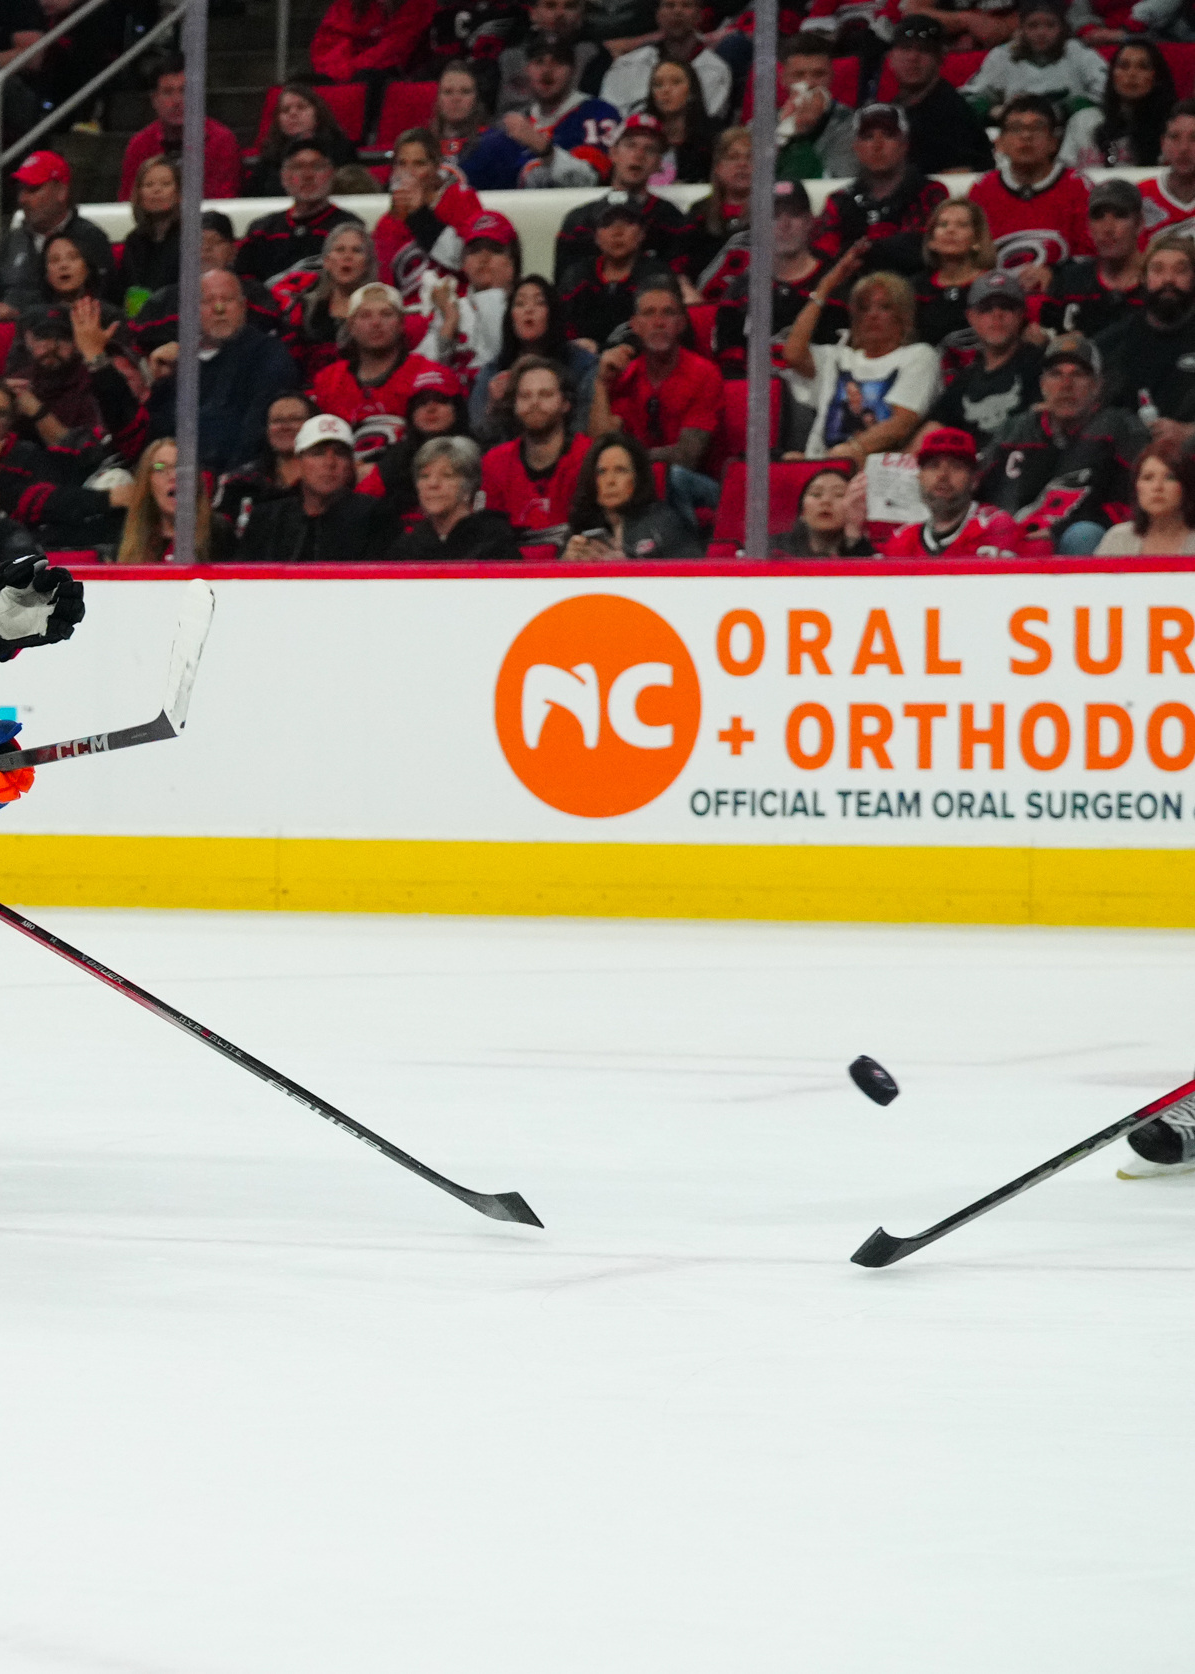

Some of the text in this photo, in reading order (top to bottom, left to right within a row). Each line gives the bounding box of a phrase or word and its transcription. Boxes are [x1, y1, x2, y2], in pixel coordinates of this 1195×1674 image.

[583, 118, 620, 148] 13
[715, 605, 1195, 678] ORAL SUR
[522, 662, 673, 749] NC
[56, 732, 109, 760] CCM
[784, 700, 1195, 772] ORTHODO
[690, 789, 1182, 820] OFFICIAL TEAM ORAL SURGEON
